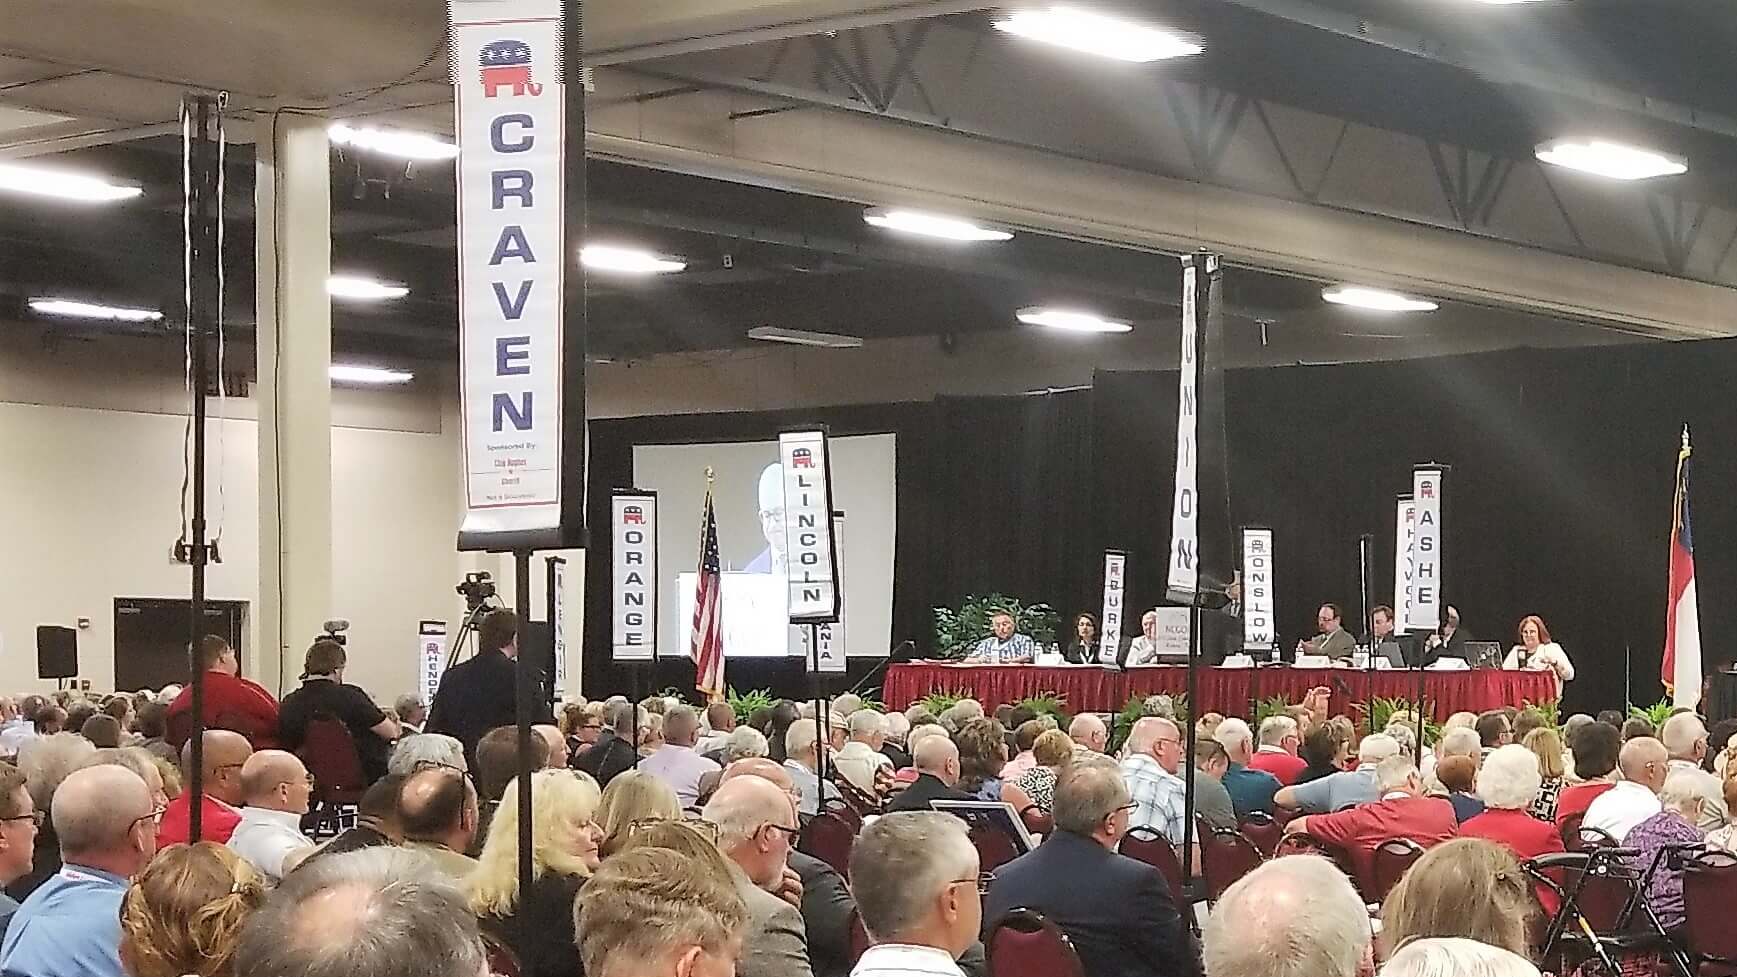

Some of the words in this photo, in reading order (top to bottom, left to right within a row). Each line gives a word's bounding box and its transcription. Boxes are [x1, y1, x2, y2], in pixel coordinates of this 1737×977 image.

[488, 113, 537, 433] CRAVEN
[1177, 333, 1192, 570] UNION
[624, 530, 644, 646] ORANGE
[797, 475, 821, 602] LINCOLN
[1418, 510, 1434, 604] ASHE
[1104, 580, 1119, 656] BURKE
[1252, 558, 1267, 642] ONSLOW
